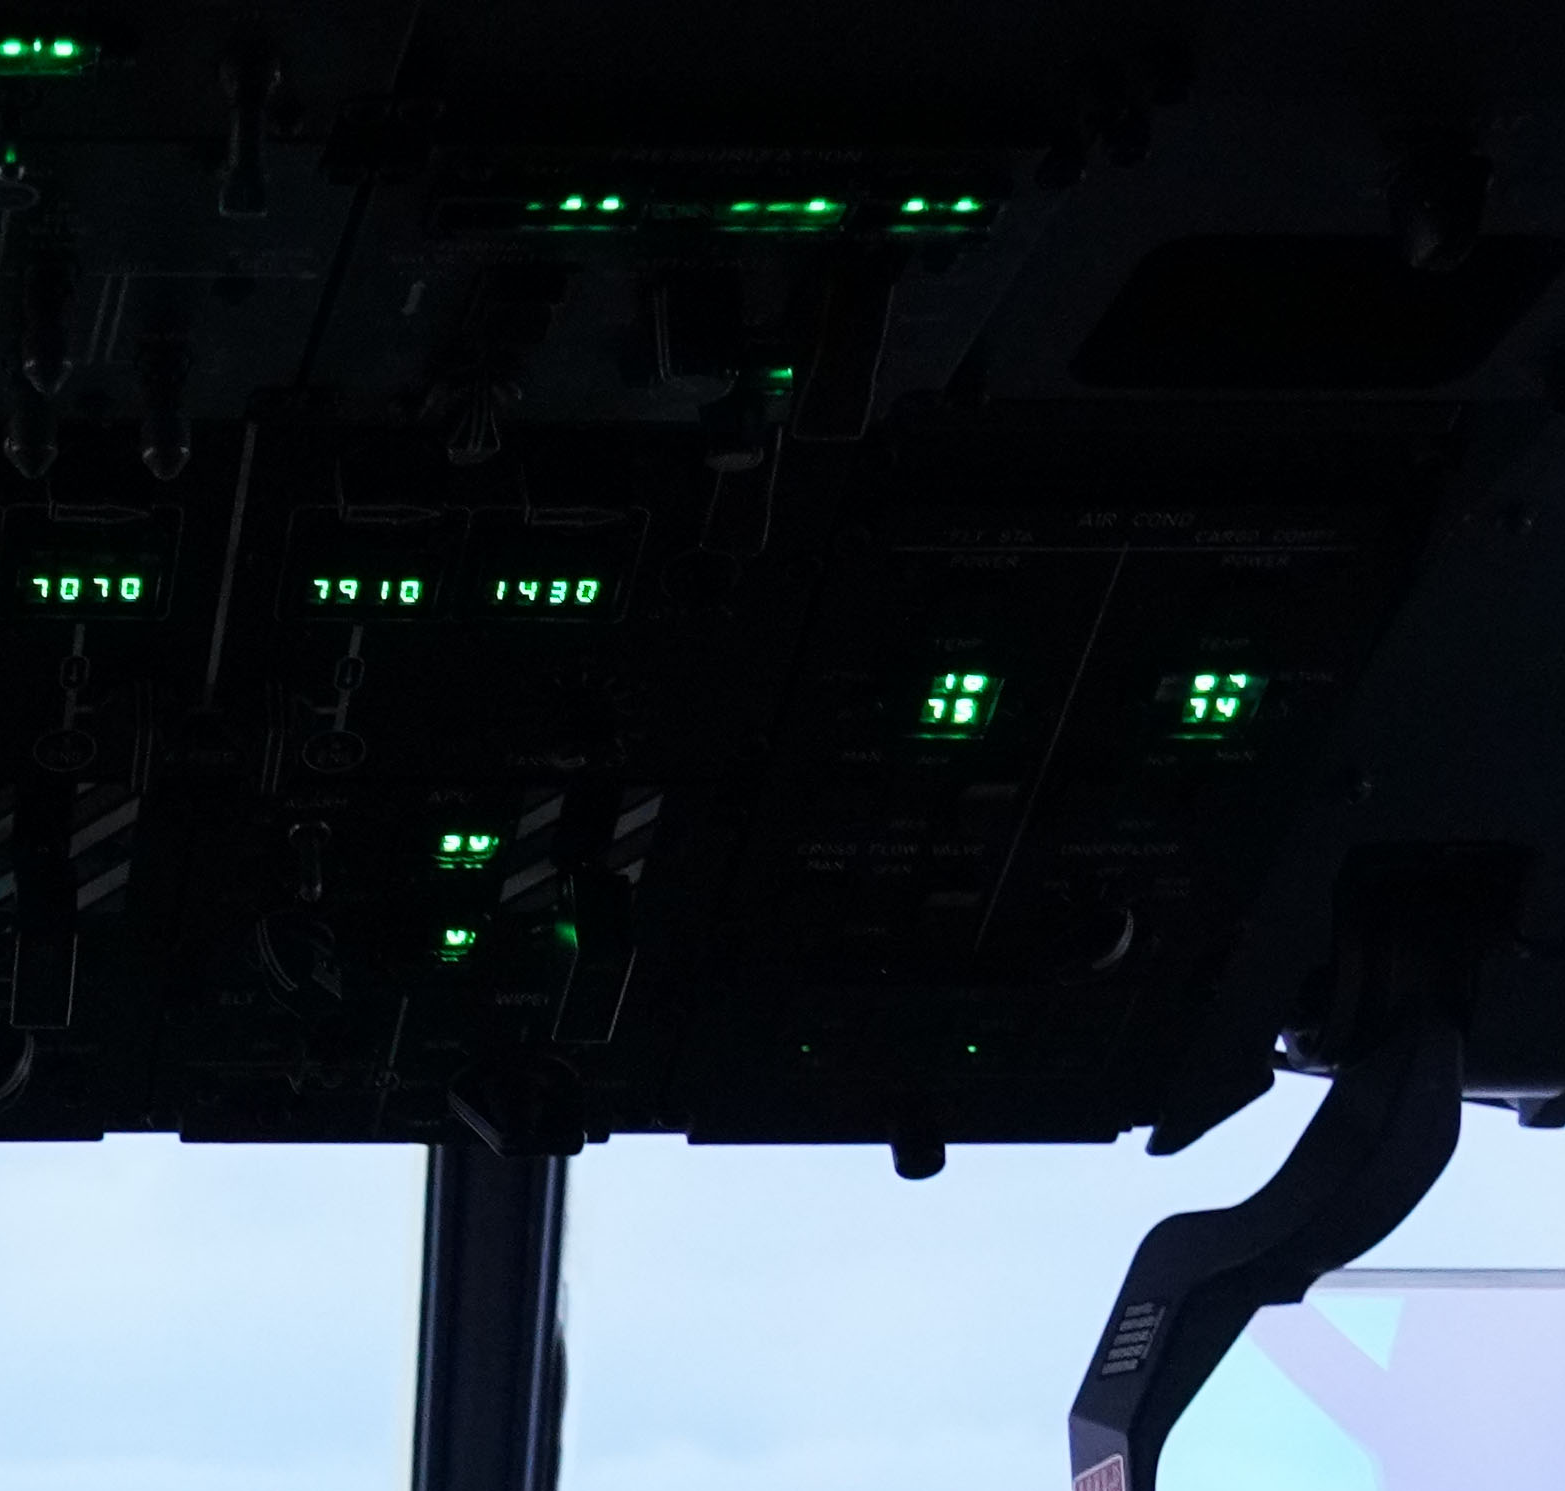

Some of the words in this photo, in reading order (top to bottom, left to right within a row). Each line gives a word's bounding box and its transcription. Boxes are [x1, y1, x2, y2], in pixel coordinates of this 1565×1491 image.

[33, 577, 142, 601] 7070
[314, 579, 422, 603] 7910
[497, 579, 599, 603] 1430
